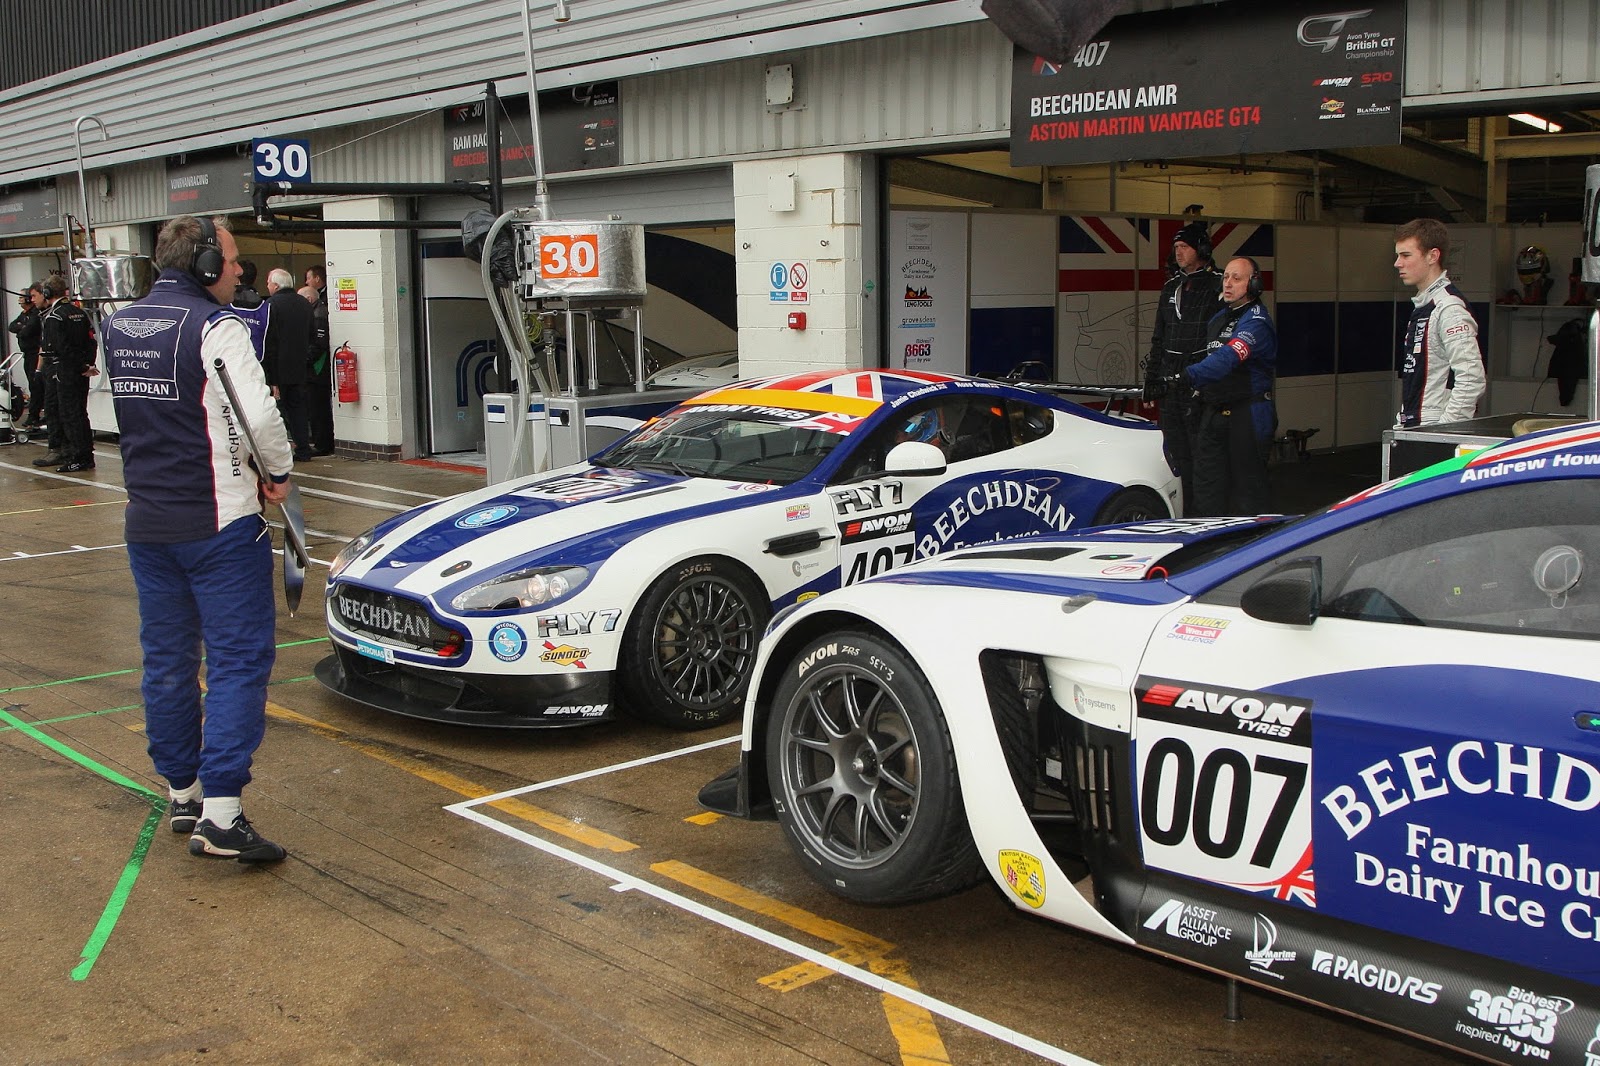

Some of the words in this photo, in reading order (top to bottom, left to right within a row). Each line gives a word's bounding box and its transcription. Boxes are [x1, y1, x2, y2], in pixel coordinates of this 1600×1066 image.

[1346, 40, 1378, 51] British
[1381, 38, 1395, 48] GT
[1364, 32, 1380, 40] Tyres
[1073, 41, 1110, 68] 407
[1345, 49, 1395, 60] Championship
[1320, 77, 1353, 86] AVON
[1361, 72, 1393, 84] SRO
[1030, 88, 1131, 117] BEECHDEAN
[1135, 84, 1178, 108] AMR
[1356, 106, 1391, 114] BLANCPAIN
[1029, 120, 1079, 142] ASTON
[1084, 115, 1145, 138] MARTIN
[1149, 108, 1224, 132] VANTAGE
[1229, 106, 1261, 127] GT4
[453, 134, 471, 150] RAM
[472, 130, 503, 148] RACG
[256, 143, 309, 178] 30
[452, 151, 487, 168] MERCEDE
[543, 241, 596, 274] 30
[901, 258, 937, 273] BEECHDEAN
[1446, 324, 1470, 336] SRO
[136, 350, 160, 358] MARTIN
[906, 344, 931, 357] 3663
[121, 360, 150, 370] RACING
[890, 395, 910, 408] Jamie
[907, 385, 938, 398] Chadwick
[683, 404, 746, 414] AVON
[748, 406, 811, 420] TYRES
[1460, 458, 1546, 483] Andrew
[1552, 454, 1600, 467] How
[829, 484, 883, 515] FLY
[883, 481, 904, 504] 7
[860, 512, 912, 534] AVON
[886, 525, 908, 534] TYRES
[917, 480, 1076, 558] BEECHDEAN
[845, 543, 915, 587] 407
[338, 594, 430, 638] BEECHDEAN
[536, 610, 597, 638] FLY
[599, 608, 622, 632] 7
[1178, 615, 1232, 630] SUNOCO
[1167, 633, 1216, 644] CHALLENGE
[1186, 626, 1216, 637] WHELEN
[543, 649, 588, 660] SUNOCO
[798, 643, 838, 678] AVON
[557, 704, 608, 714] AVON
[1174, 690, 1306, 726] AVON
[1237, 718, 1292, 738] TYRES
[1321, 740, 1600, 840] BEECHD
[1141, 737, 1308, 869] 007
[1406, 822, 1600, 899] Farmhou
[1354, 852, 1464, 914] Dairy
[1479, 880, 1546, 928] Ice
[1183, 904, 1217, 922] ASSET
[1178, 926, 1218, 948] GROUP
[1180, 916, 1232, 940] ALLIANCE
[1265, 950, 1297, 959] Marine
[1507, 986, 1562, 1012] Bidvest
[1467, 989, 1558, 1045] 3663
[1455, 1020, 1501, 1045] inspired
[1502, 1034, 1522, 1054] by
[1522, 1042, 1551, 1060] you
